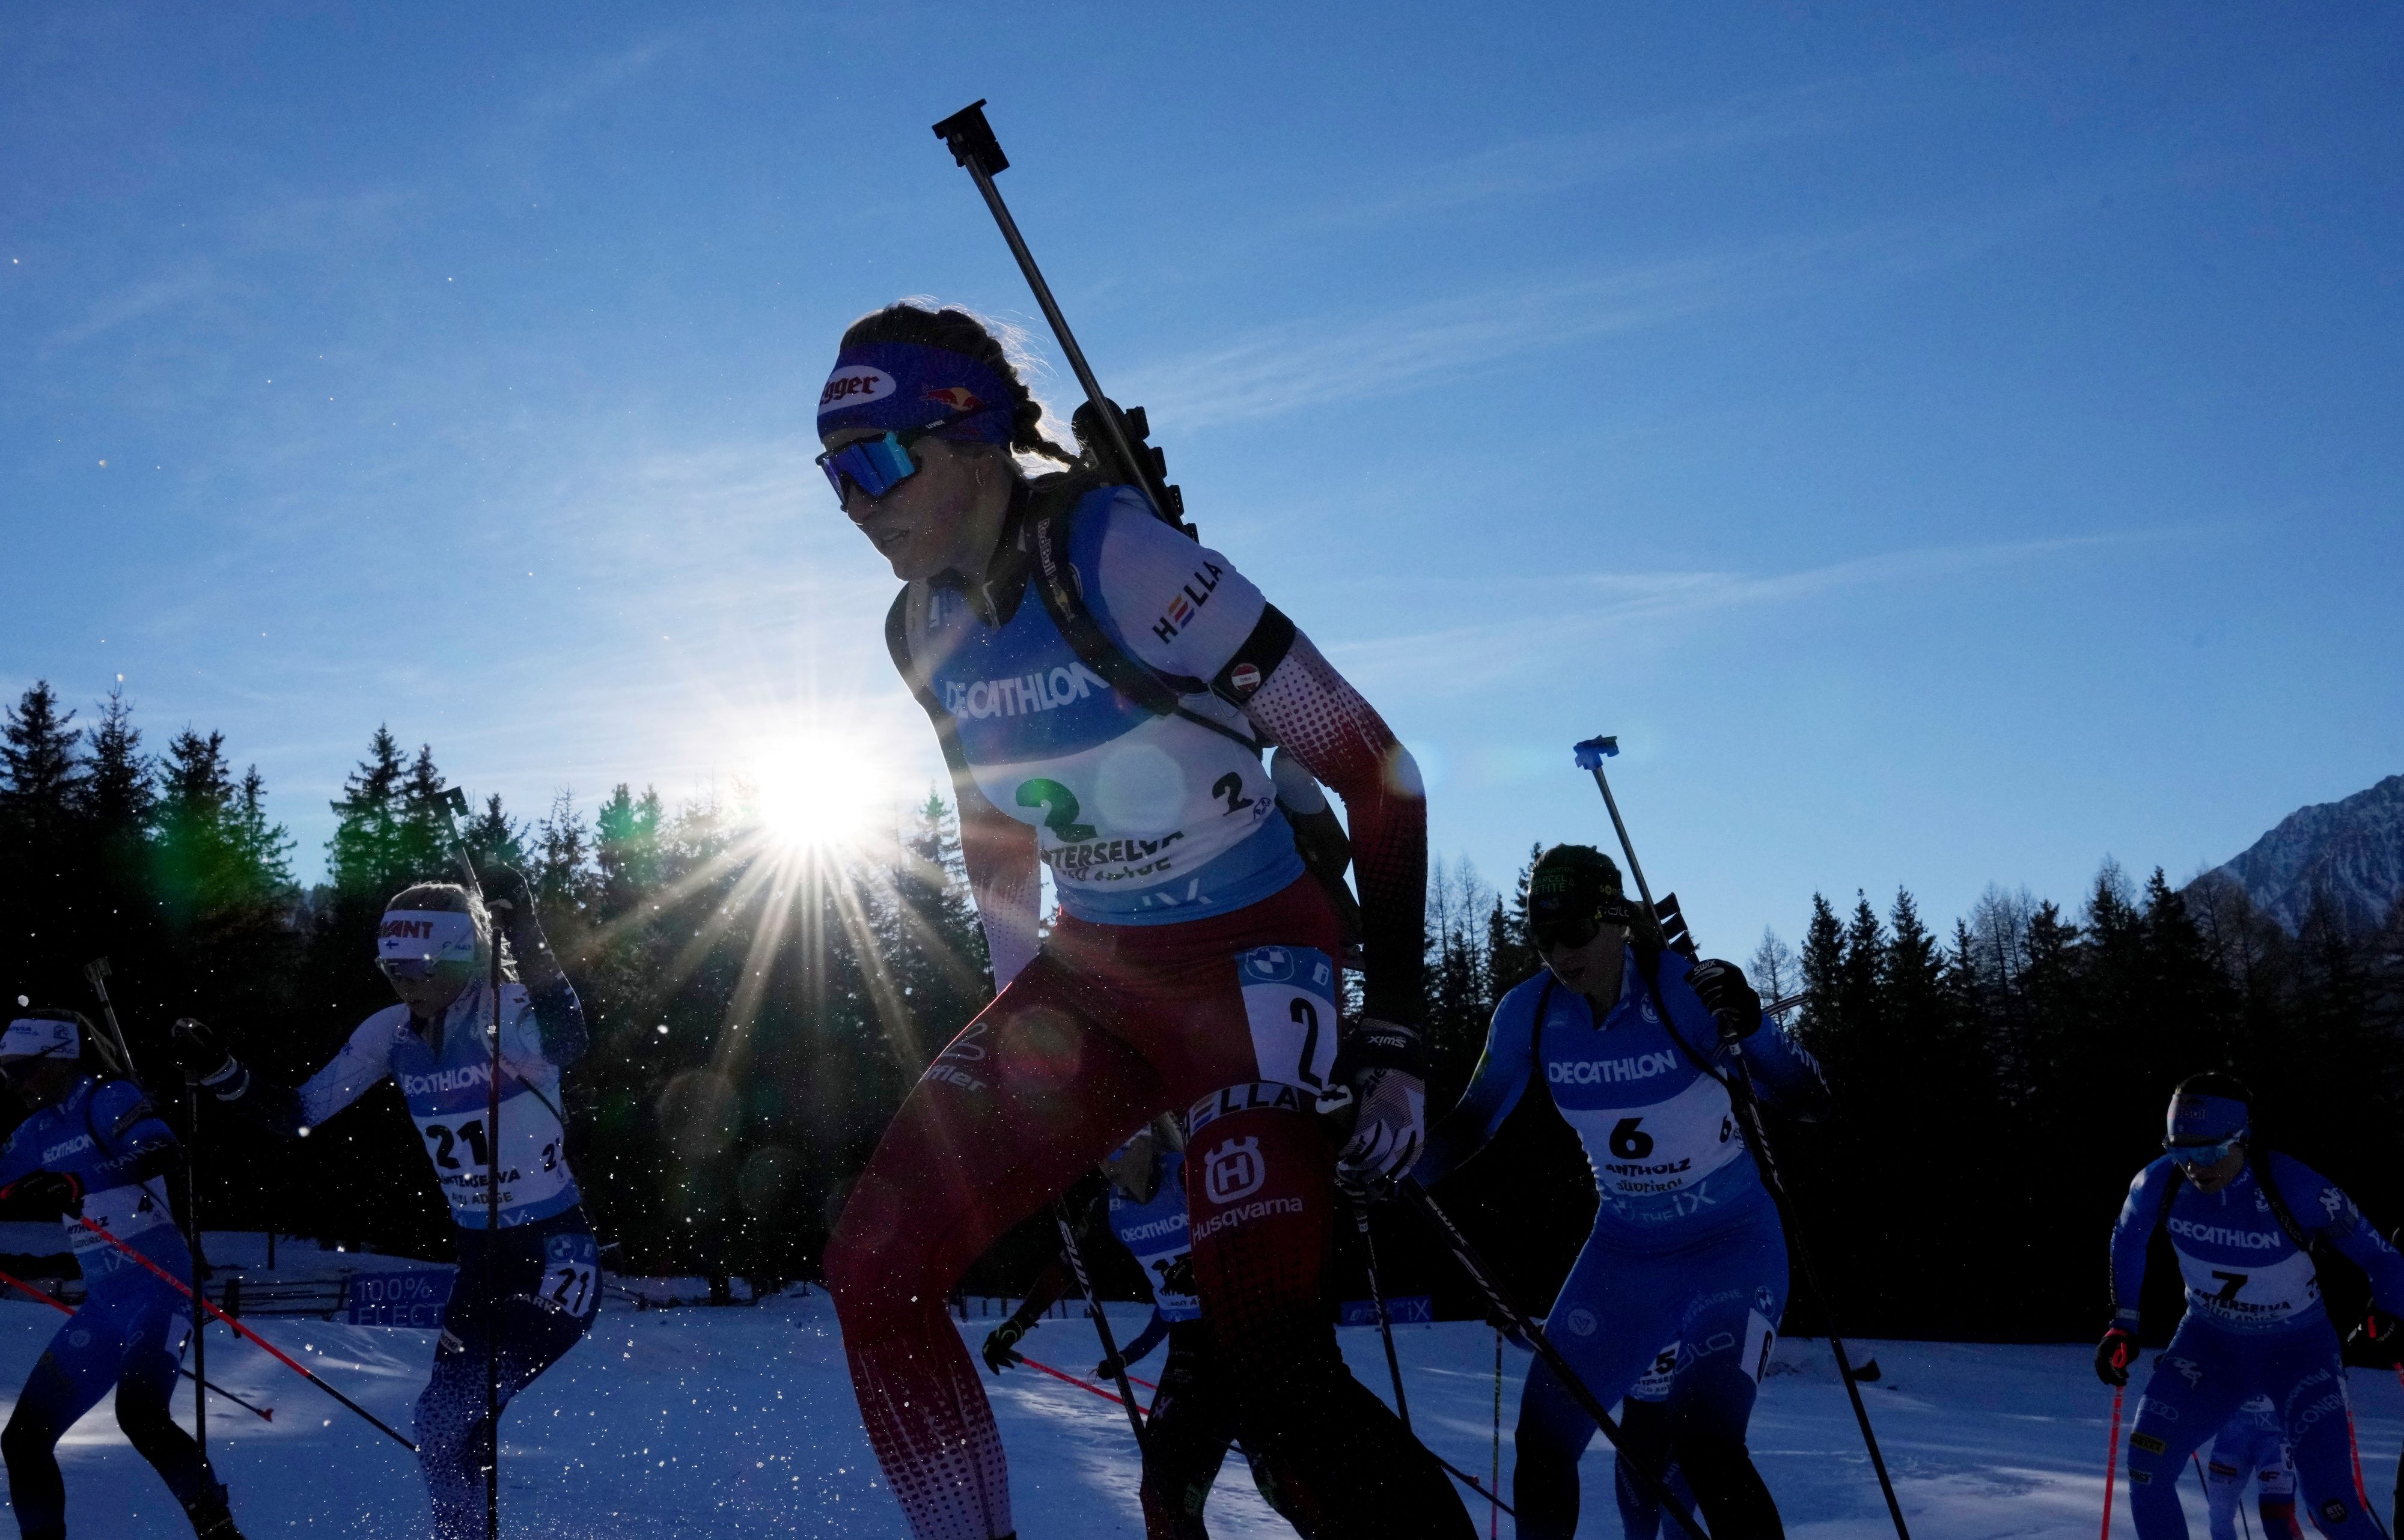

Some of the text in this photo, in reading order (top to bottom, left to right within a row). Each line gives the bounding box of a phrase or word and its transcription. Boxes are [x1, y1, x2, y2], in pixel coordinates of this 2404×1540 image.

[820, 377, 880, 405] gger
[926, 419, 946, 429] uvex
[1152, 561, 1223, 644] HELLA
[945, 662, 1111, 719] DECATHLON
[1016, 778, 1098, 842] 2
[1212, 772, 1254, 817] 2
[1290, 997, 1326, 1088] 2
[1548, 1049, 1678, 1084] DECATHLON
[425, 1120, 488, 1170] 21
[1610, 1118, 1653, 1160] 6
[1605, 1158, 1691, 1176] ANTHOLZ
[1192, 1197, 1303, 1247] Husqvarna
[2168, 1217, 2280, 1249] DECATHLON
[357, 1277, 432, 1303] 100%
[553, 1268, 590, 1314] 21
[2212, 1270, 2247, 1299] 7
[358, 1303, 445, 1327] ELECT
